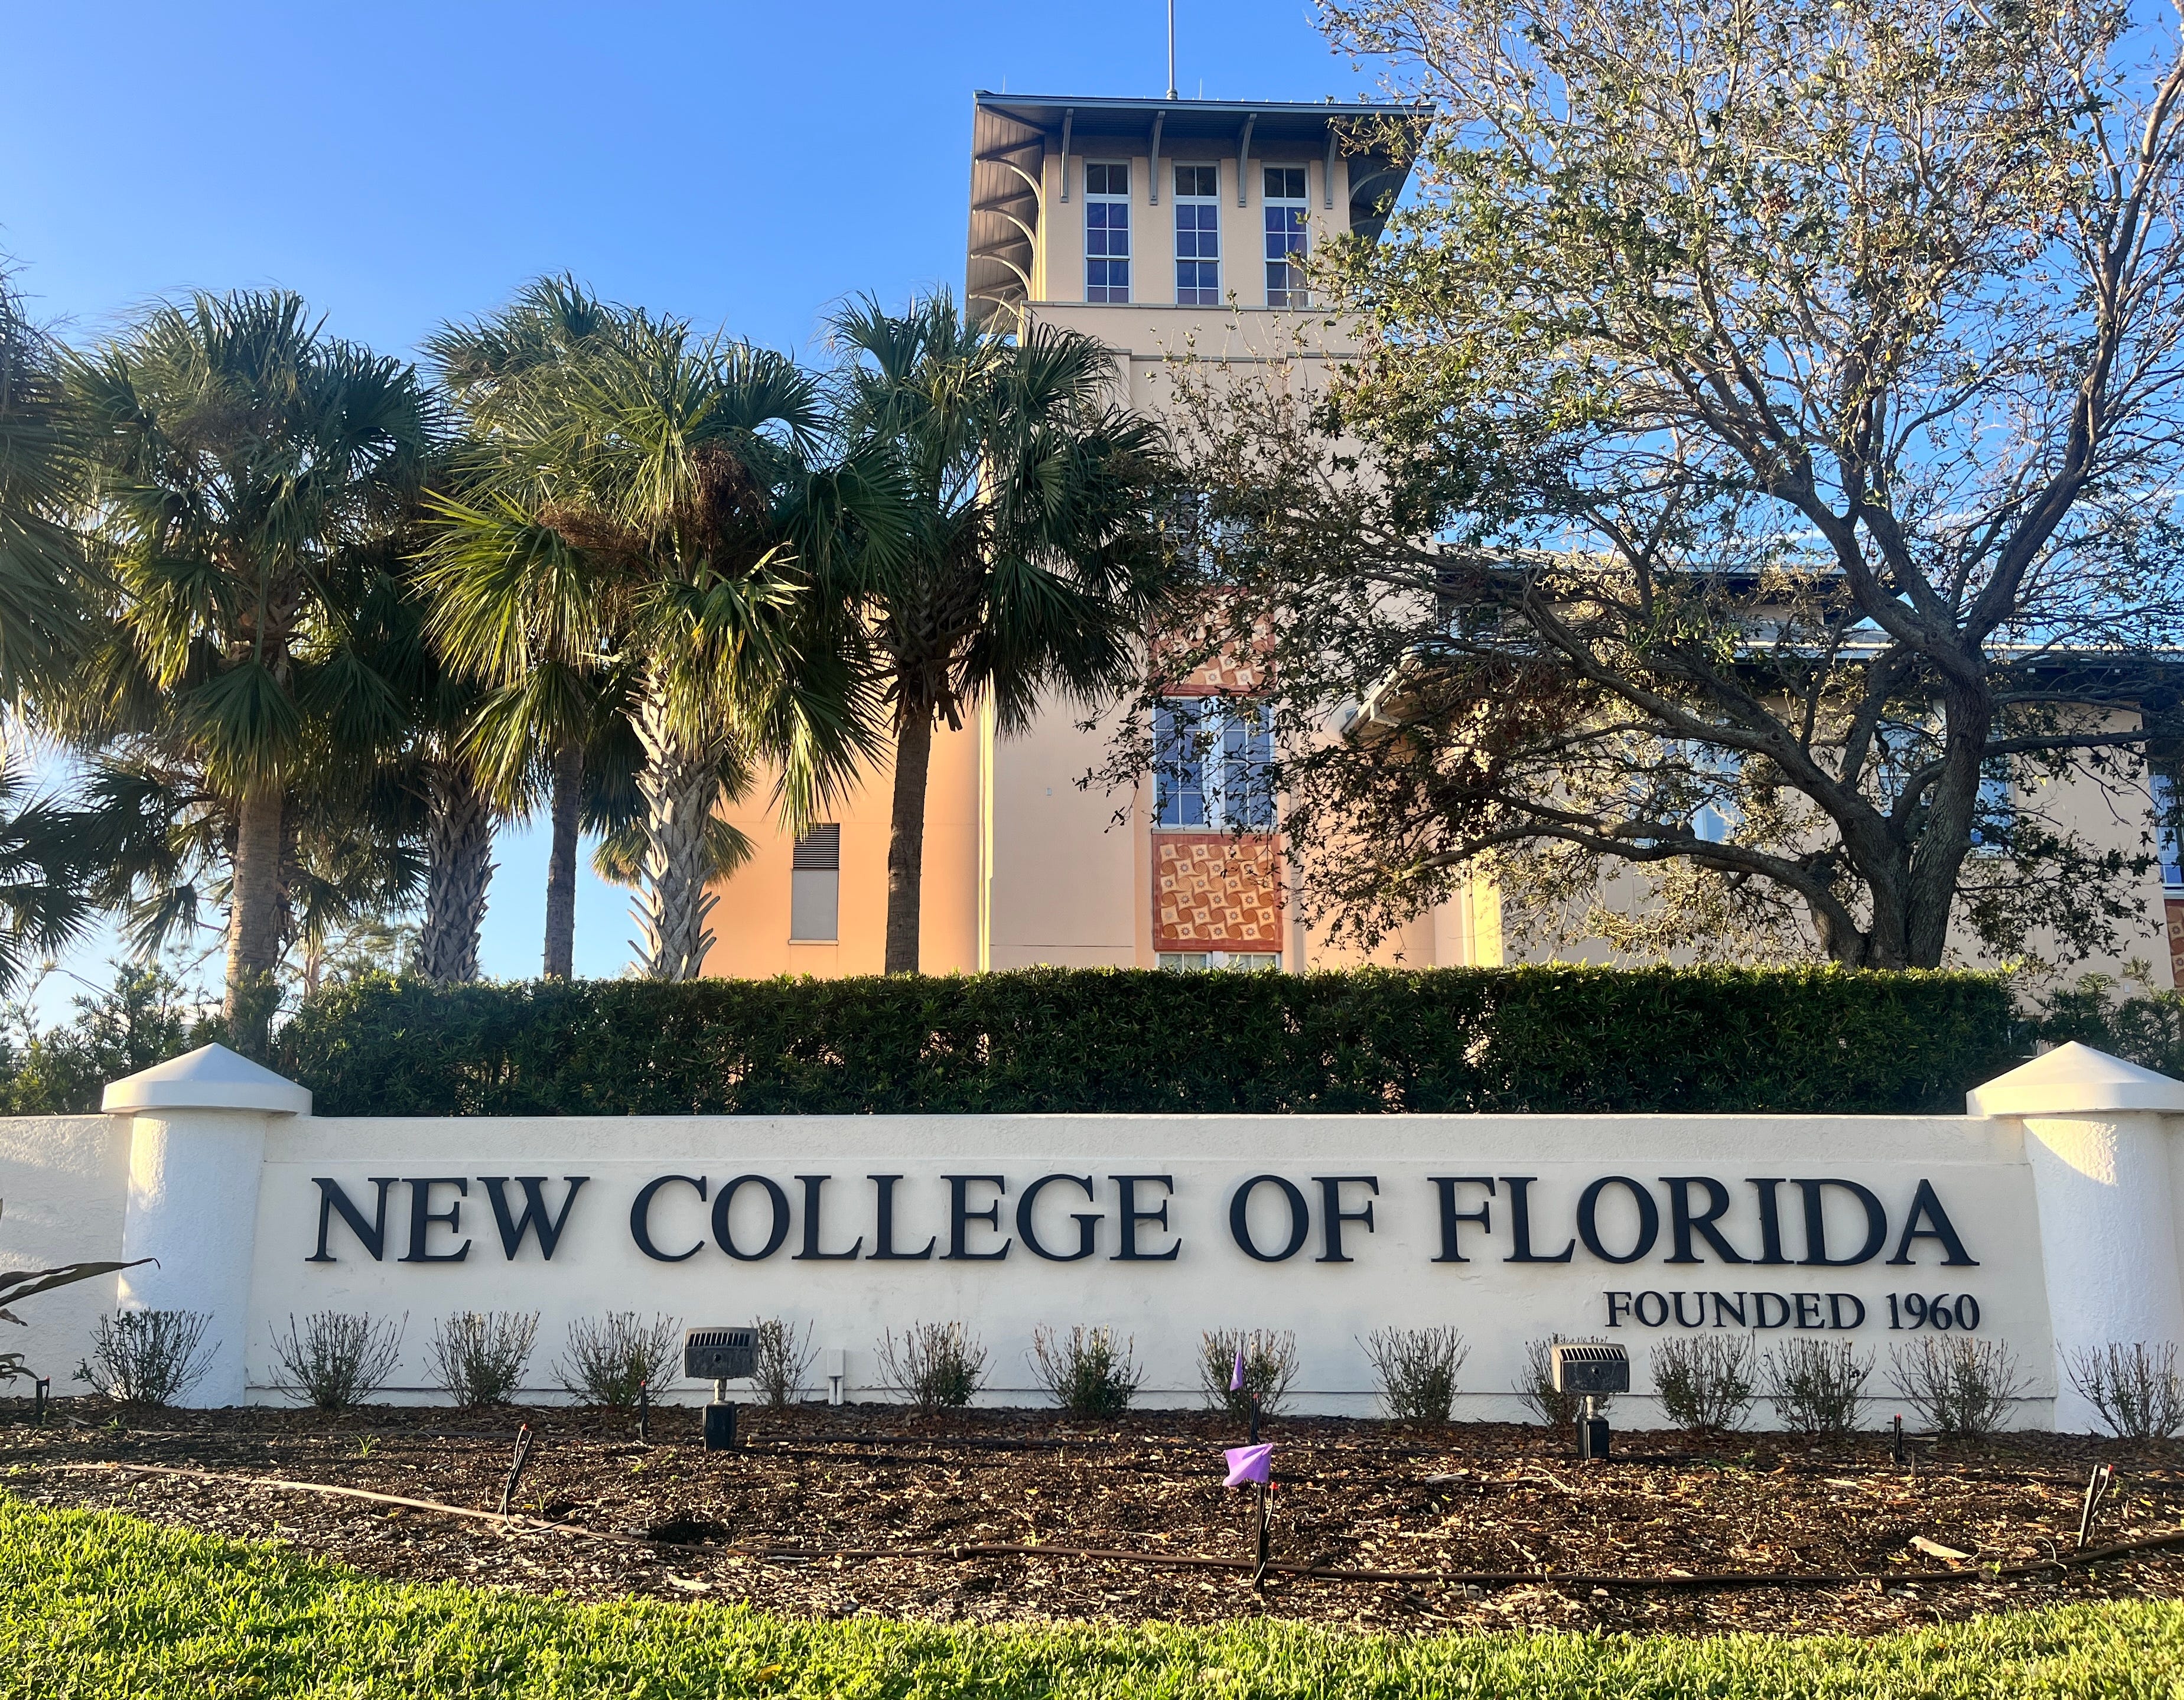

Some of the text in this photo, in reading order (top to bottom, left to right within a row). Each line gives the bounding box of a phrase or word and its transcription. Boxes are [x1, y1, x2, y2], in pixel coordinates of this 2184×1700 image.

[305, 1174, 1980, 1266] NEW COLLEGE OF FLORIDA
[1603, 1291, 1981, 1331] FOUNDED 1960
